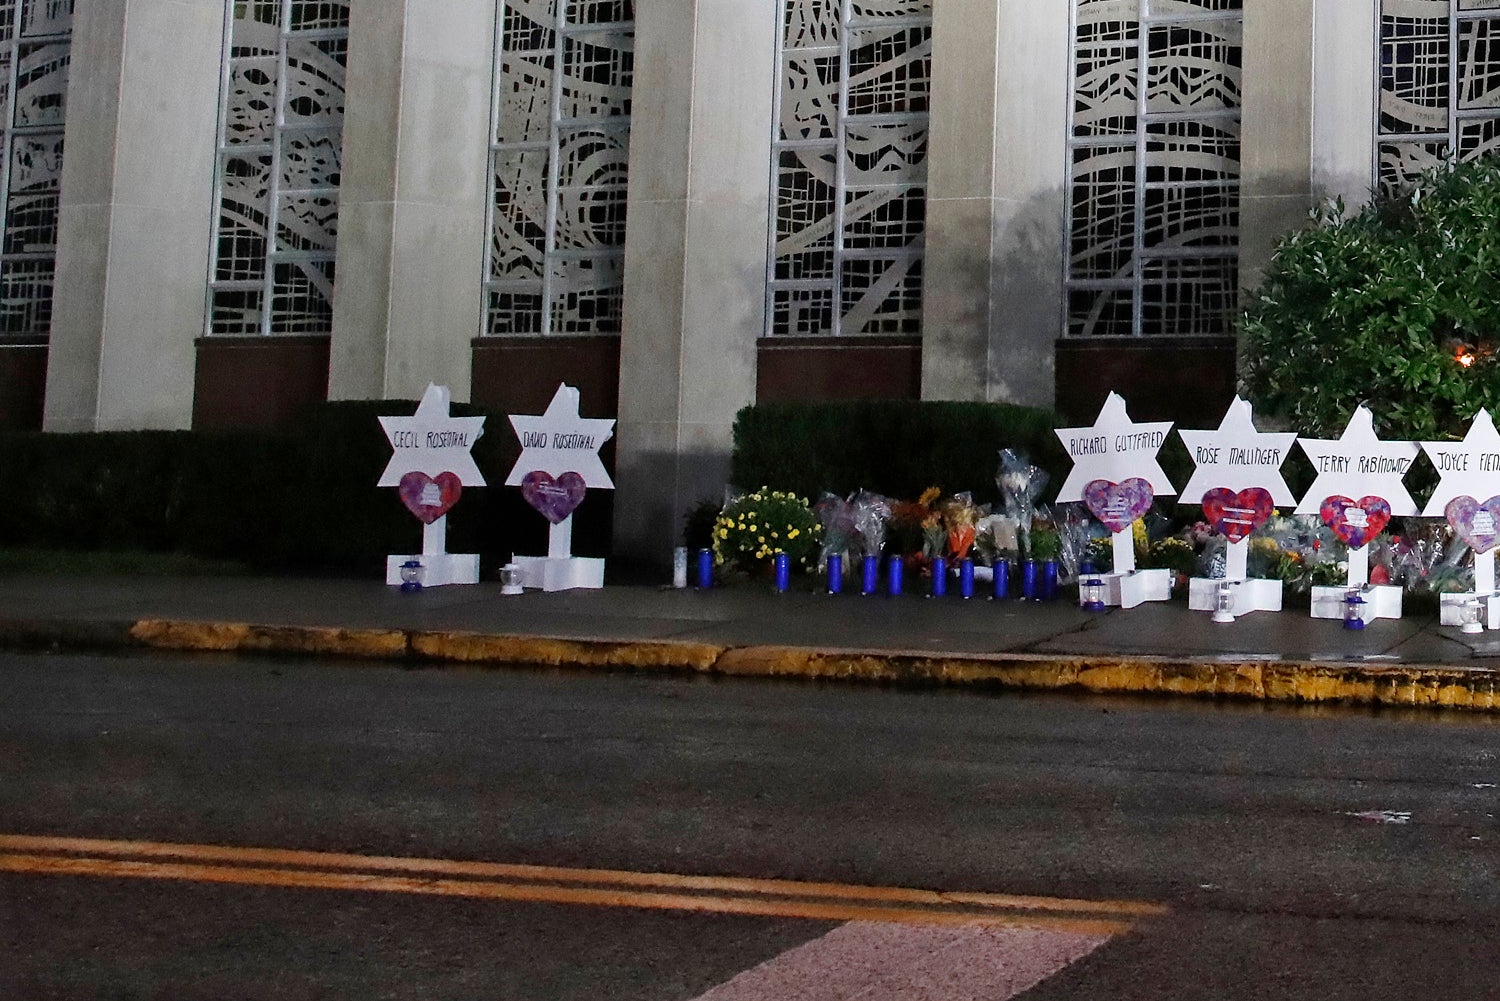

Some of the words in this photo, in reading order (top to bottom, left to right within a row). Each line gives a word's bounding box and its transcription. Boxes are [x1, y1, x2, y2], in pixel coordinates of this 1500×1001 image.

[394, 431, 419, 449] CECIL
[1070, 436, 1107, 456] RICHARD
[1196, 446, 1221, 464] ROSE
[1228, 447, 1280, 465] MALLINGER
[1317, 455, 1351, 474] TERRY
[1437, 451, 1469, 471] JOYCE
